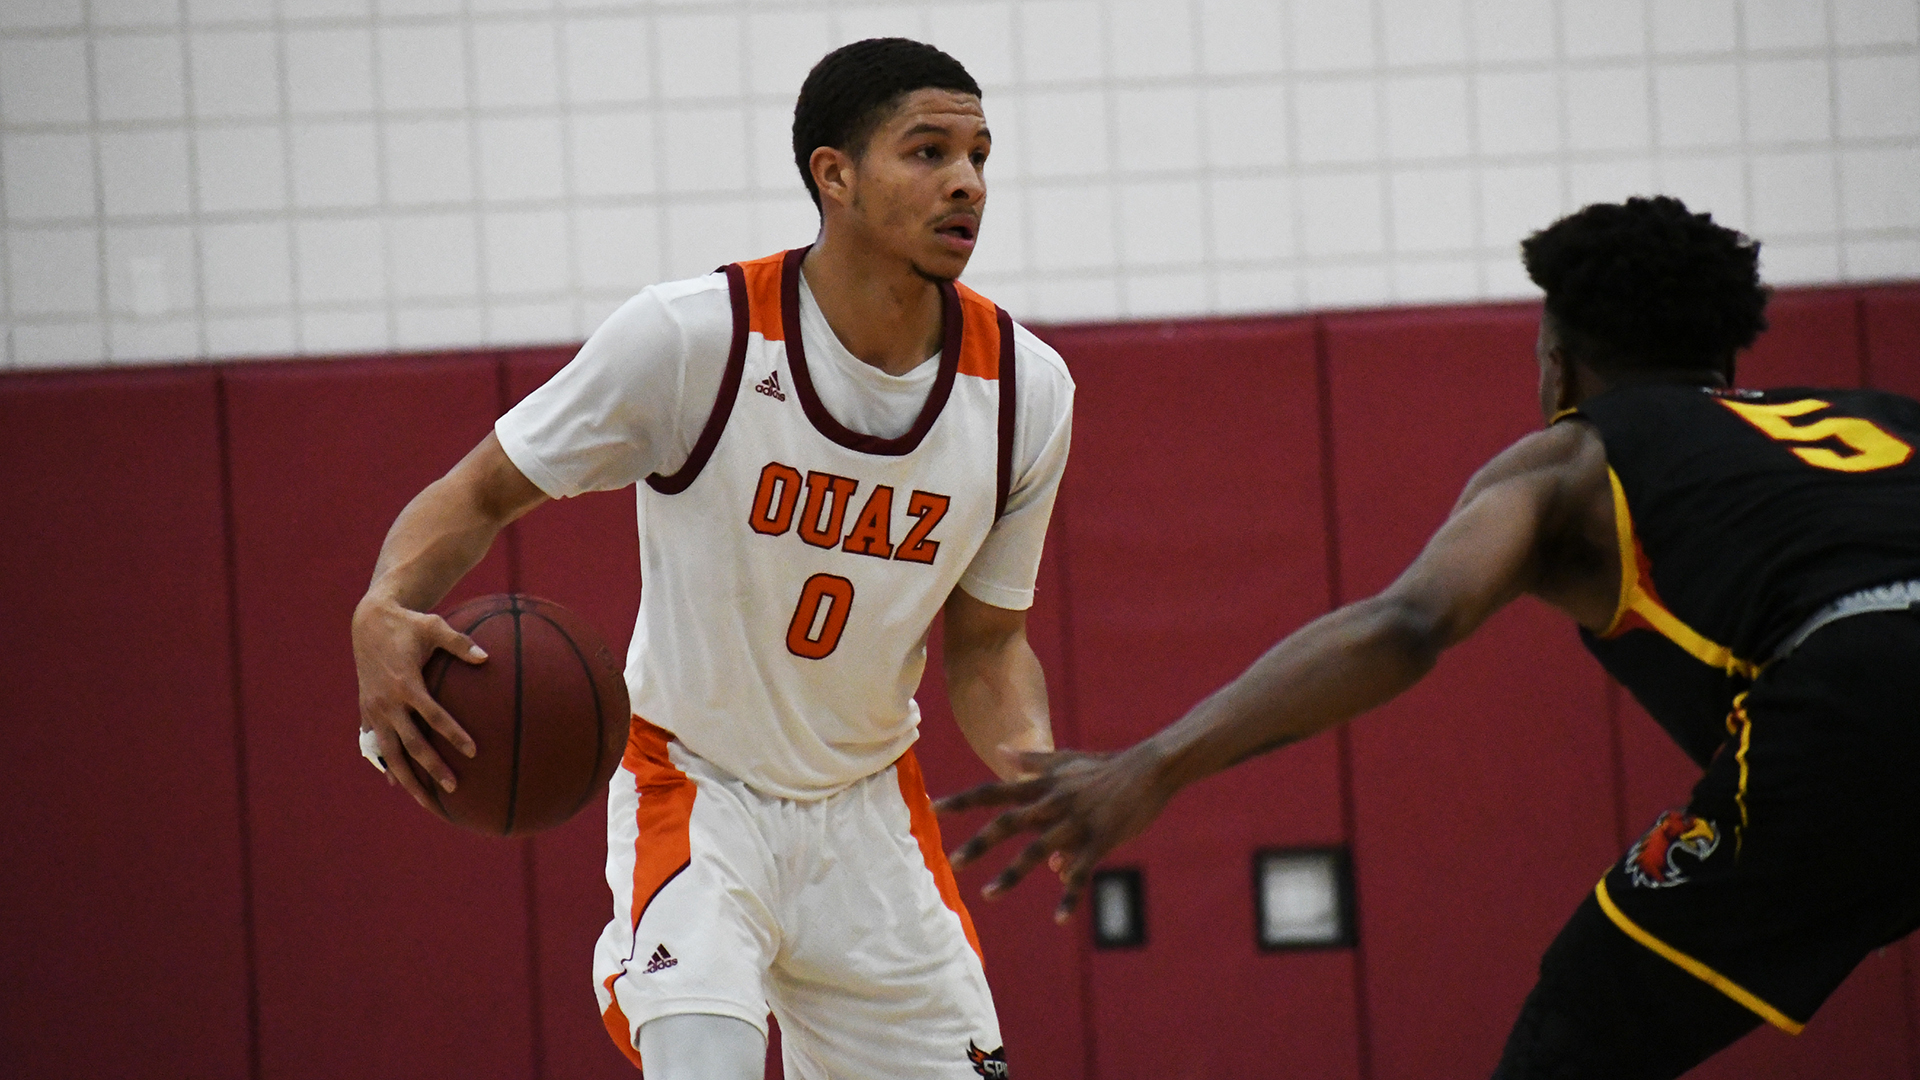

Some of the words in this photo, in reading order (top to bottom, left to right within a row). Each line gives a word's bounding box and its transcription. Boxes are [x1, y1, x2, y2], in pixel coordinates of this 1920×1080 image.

[755, 384, 786, 402] adidas
[1714, 398, 1913, 473] 5
[749, 461, 951, 565] OUAZ
[786, 572, 855, 660] 0
